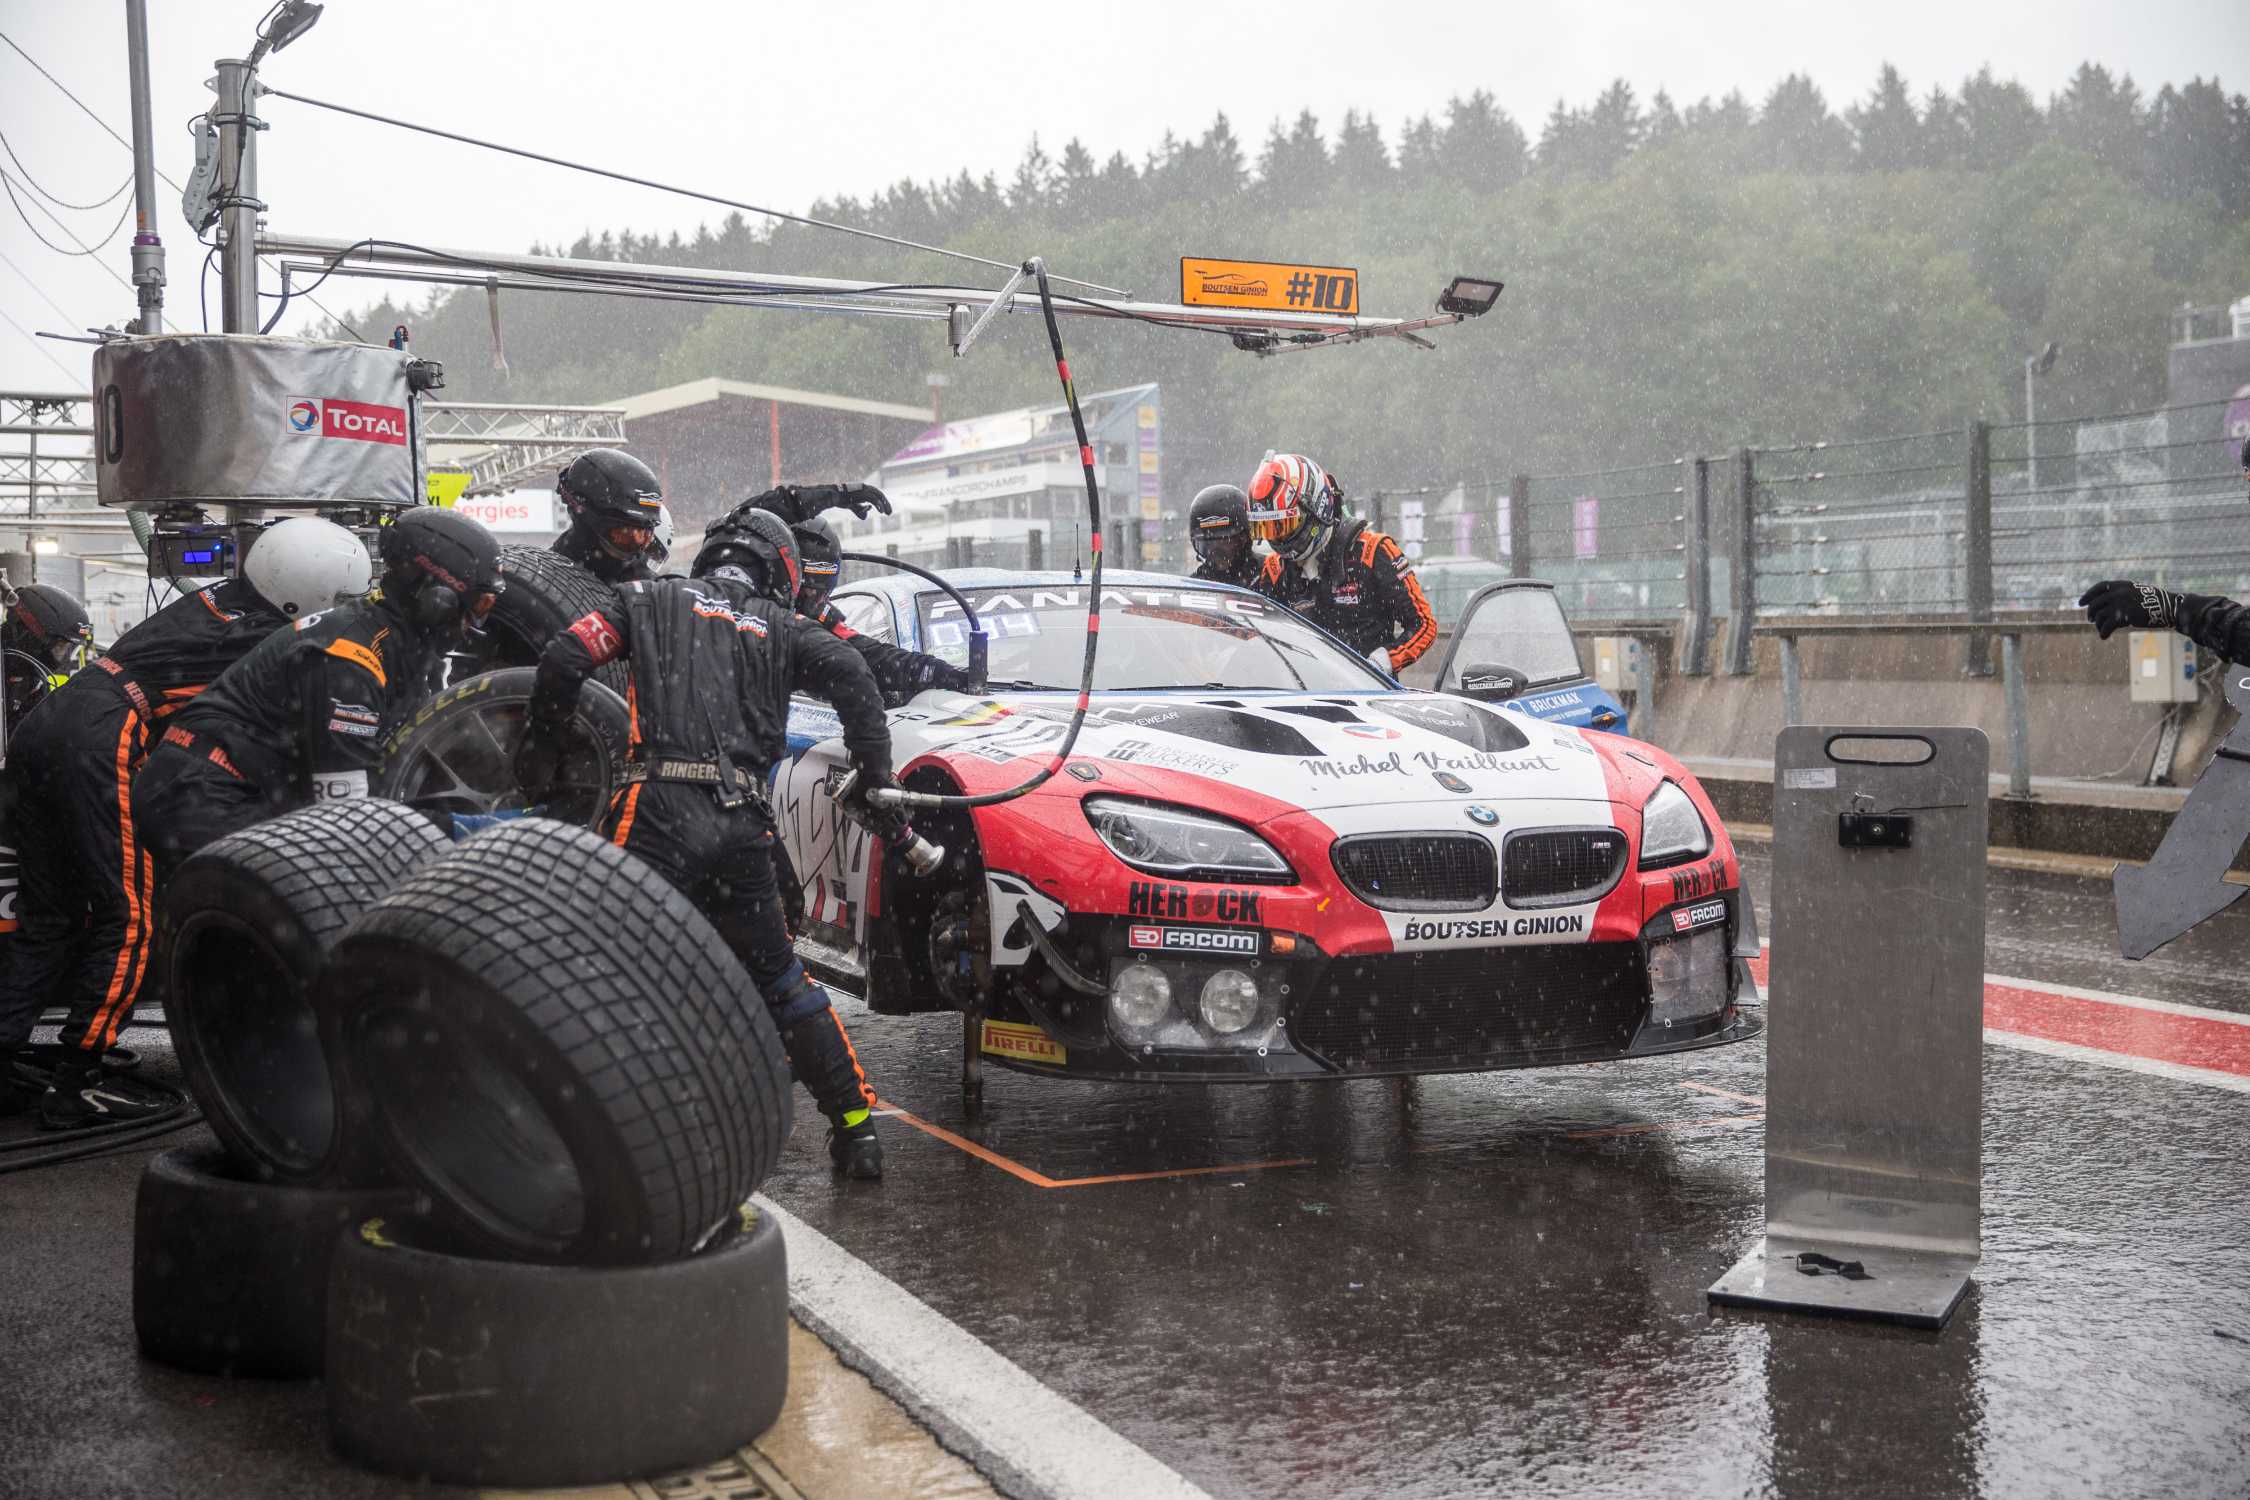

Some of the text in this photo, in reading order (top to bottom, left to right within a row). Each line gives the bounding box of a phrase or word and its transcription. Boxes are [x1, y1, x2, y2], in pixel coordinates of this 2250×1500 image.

[1202, 283, 1239, 293] BOUTSEN
[1286, 272, 1354, 310] #10
[327, 408, 404, 437] TOTAL
[930, 591, 1265, 619] FANATEC
[1529, 691, 1584, 713] BRICKMAX
[1300, 750, 1560, 779] Michel Vaillant
[1691, 903, 1725, 923] FACOM
[1166, 932, 1254, 950] FACOM
[1404, 915, 1584, 941] BOUTSEN GINION
[984, 1024, 1057, 1057] PIRELLI
